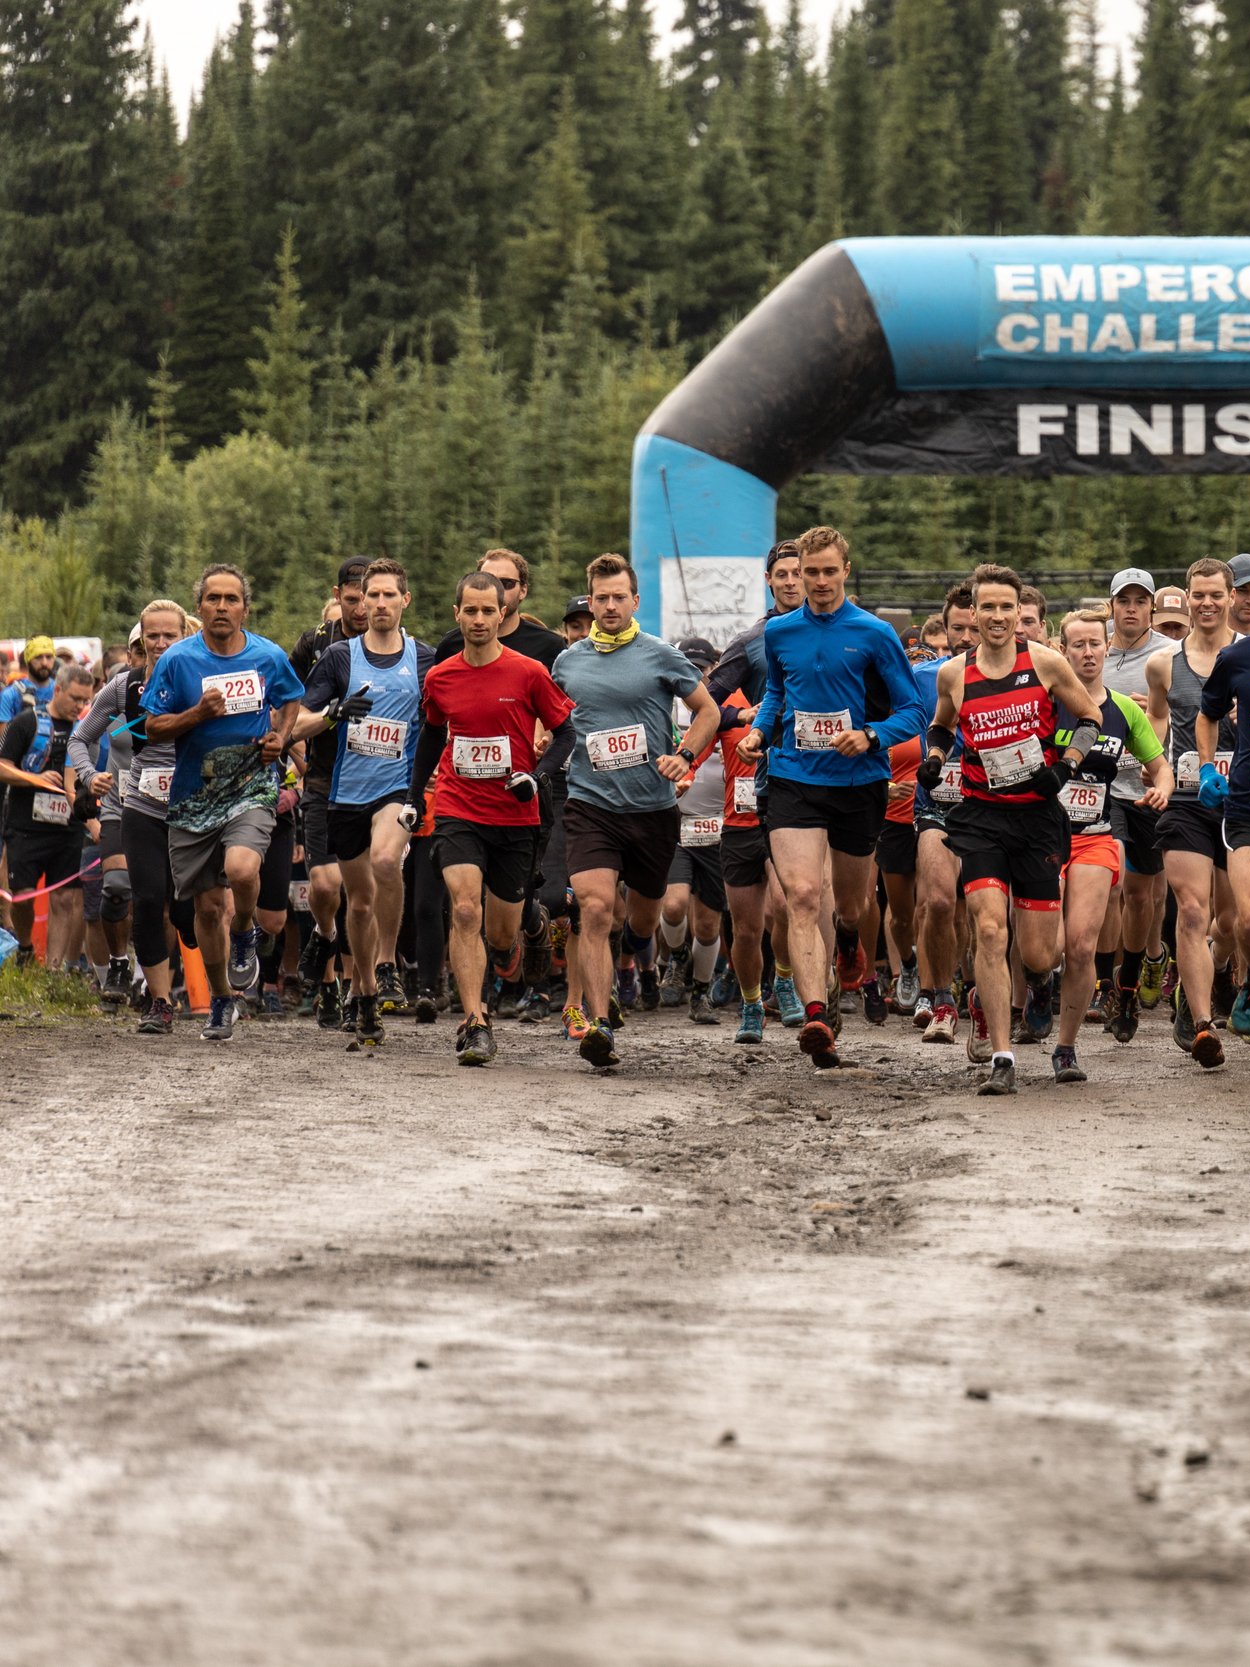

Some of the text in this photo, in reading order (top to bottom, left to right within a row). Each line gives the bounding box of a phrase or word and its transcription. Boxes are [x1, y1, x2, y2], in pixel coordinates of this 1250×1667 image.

[224, 678, 256, 699] 223
[366, 723, 401, 745] 1104
[812, 719, 845, 736] 484
[973, 725, 1018, 743] ATHLETIC
[607, 733, 638, 754] 867
[471, 745, 502, 763] 278
[1014, 749, 1025, 766] 1
[1068, 787, 1098, 807] 785
[49, 800, 67, 814] 418
[693, 819, 719, 834] 596
